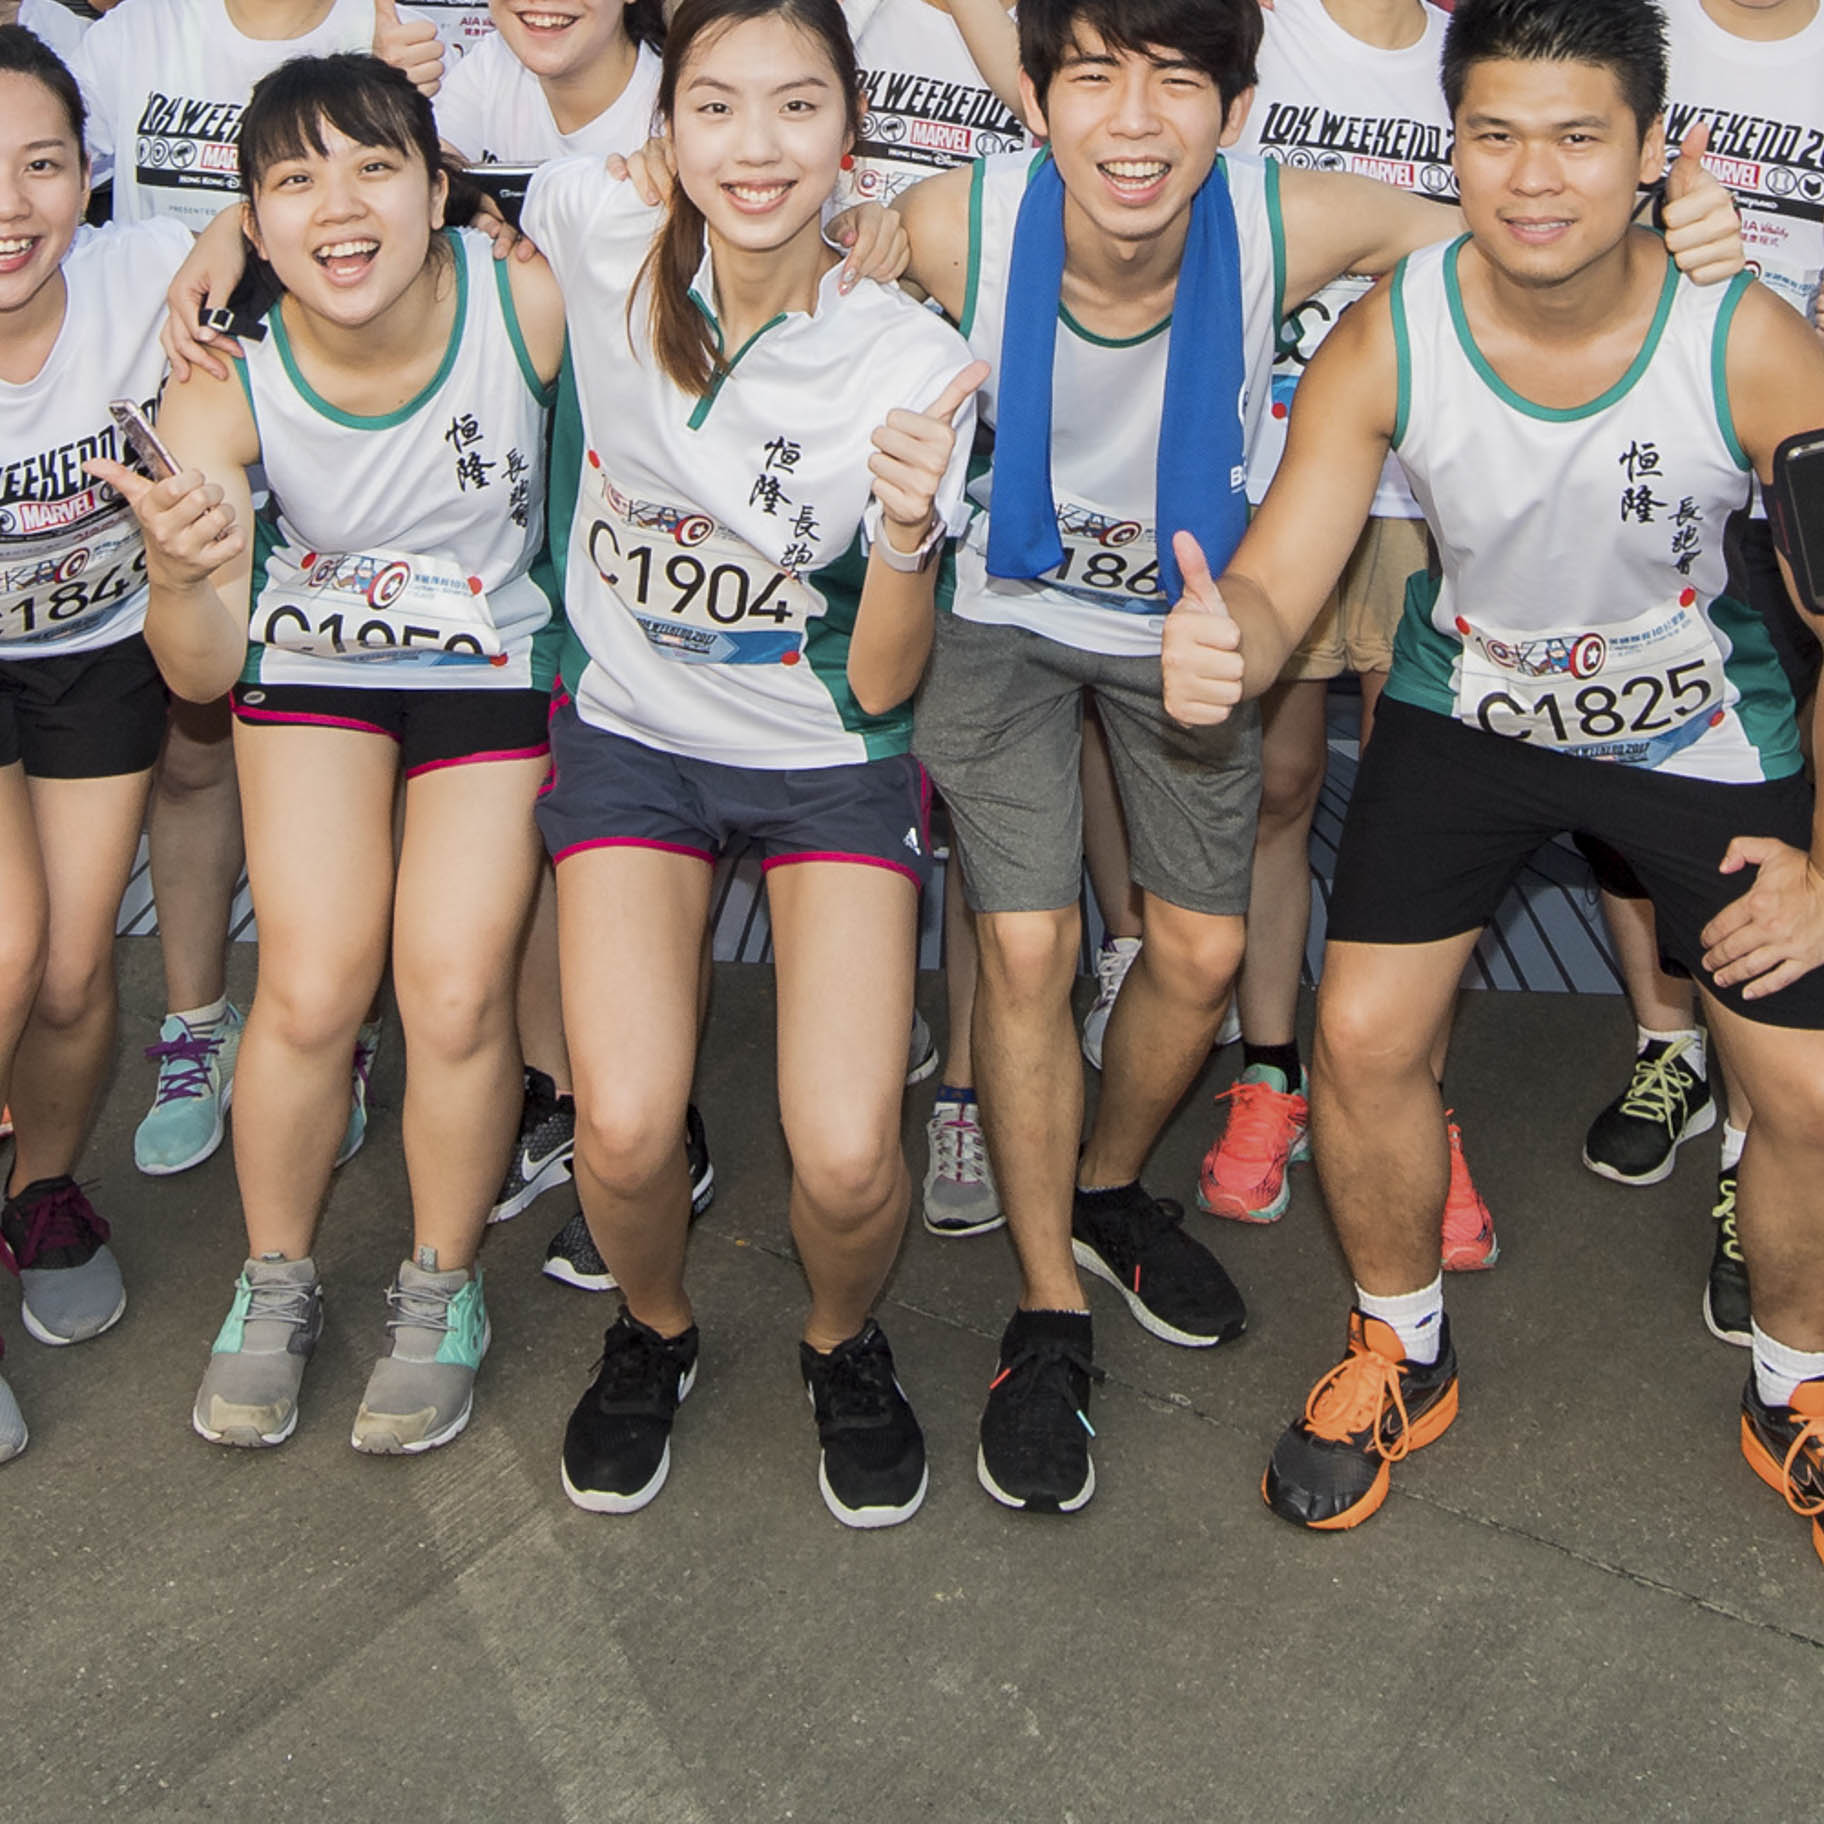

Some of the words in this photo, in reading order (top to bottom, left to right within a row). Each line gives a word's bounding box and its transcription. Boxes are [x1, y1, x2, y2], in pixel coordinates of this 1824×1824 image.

[912, 122, 970, 152] MARVEL
[1260, 103, 1319, 147] 10K
[1320, 110, 1441, 163] WEEKEND
[20, 492, 95, 532] MARVEL
[588, 518, 794, 625] C1904
[1476, 658, 1712, 742] C1825
